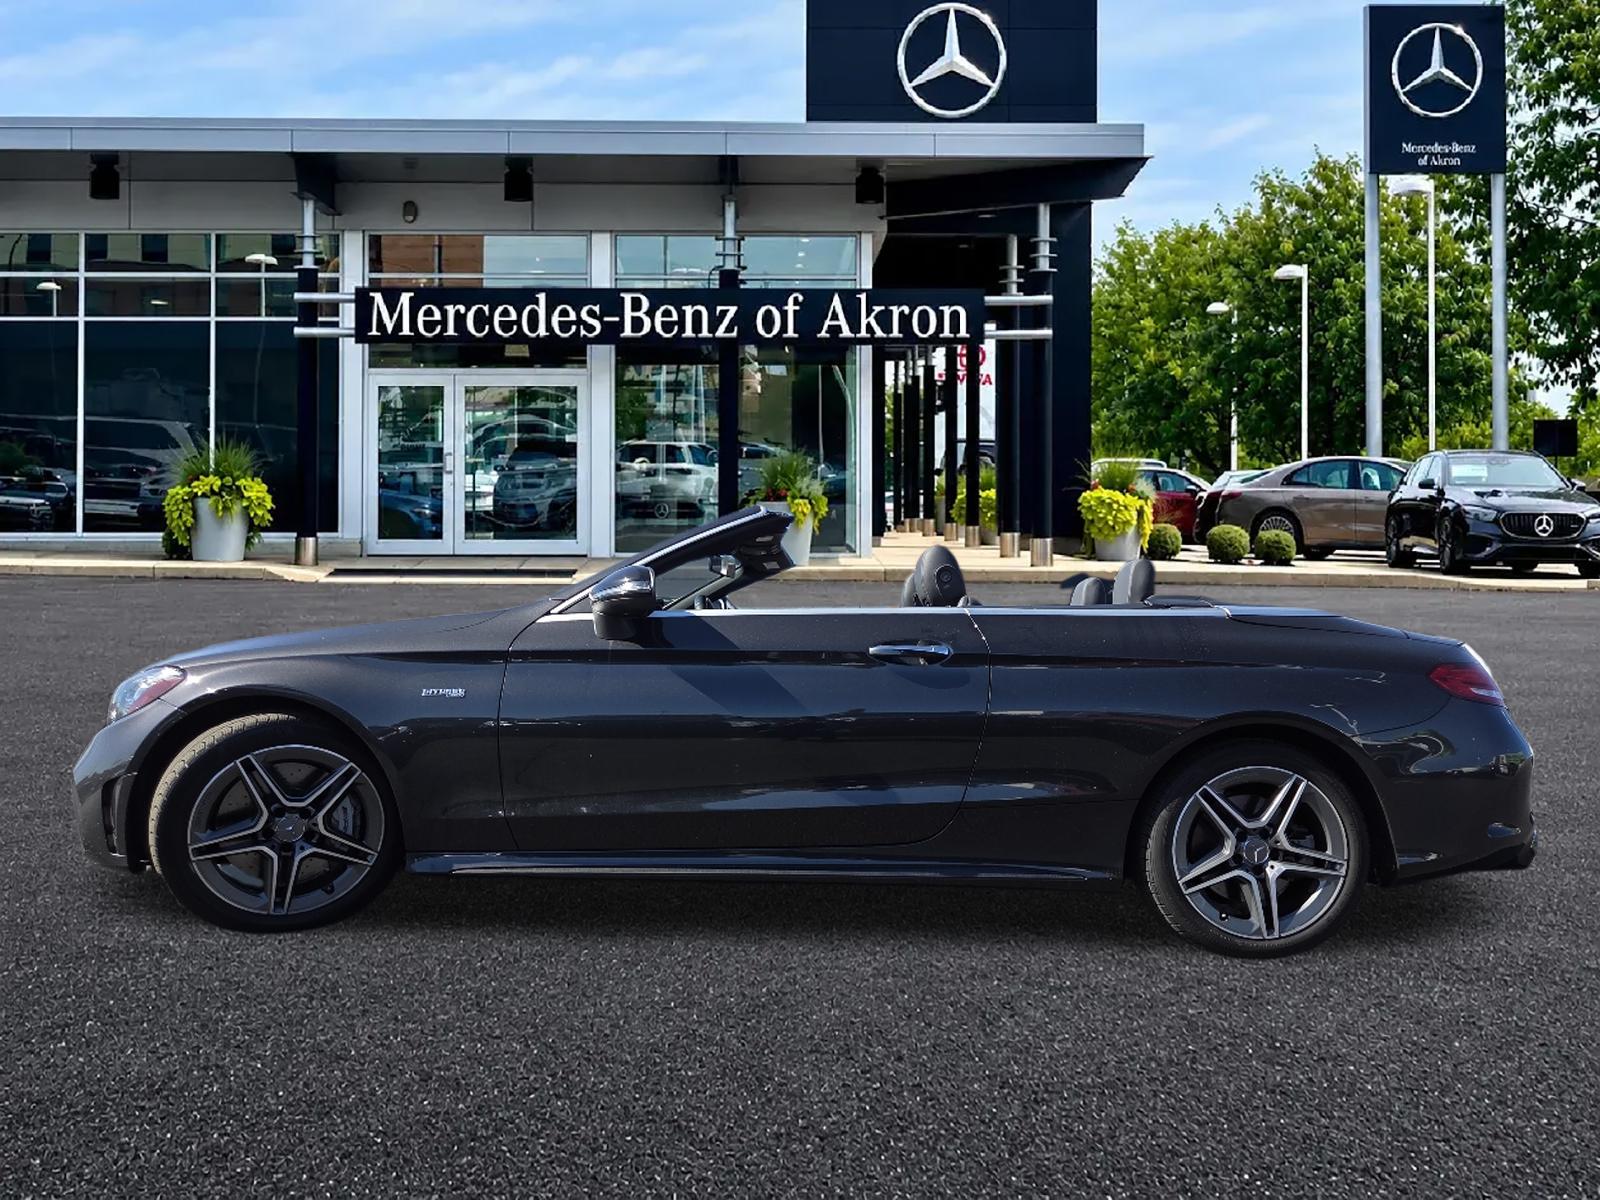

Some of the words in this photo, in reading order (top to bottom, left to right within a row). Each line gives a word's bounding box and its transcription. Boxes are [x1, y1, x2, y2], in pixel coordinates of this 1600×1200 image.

[1401, 142, 1476, 153] Mercedes-Benz
[1417, 154, 1428, 165] of
[1430, 155, 1461, 165] Akron
[367, 292, 738, 338] Mercedes-Benz
[755, 292, 801, 338] of
[816, 292, 970, 338] Akron
